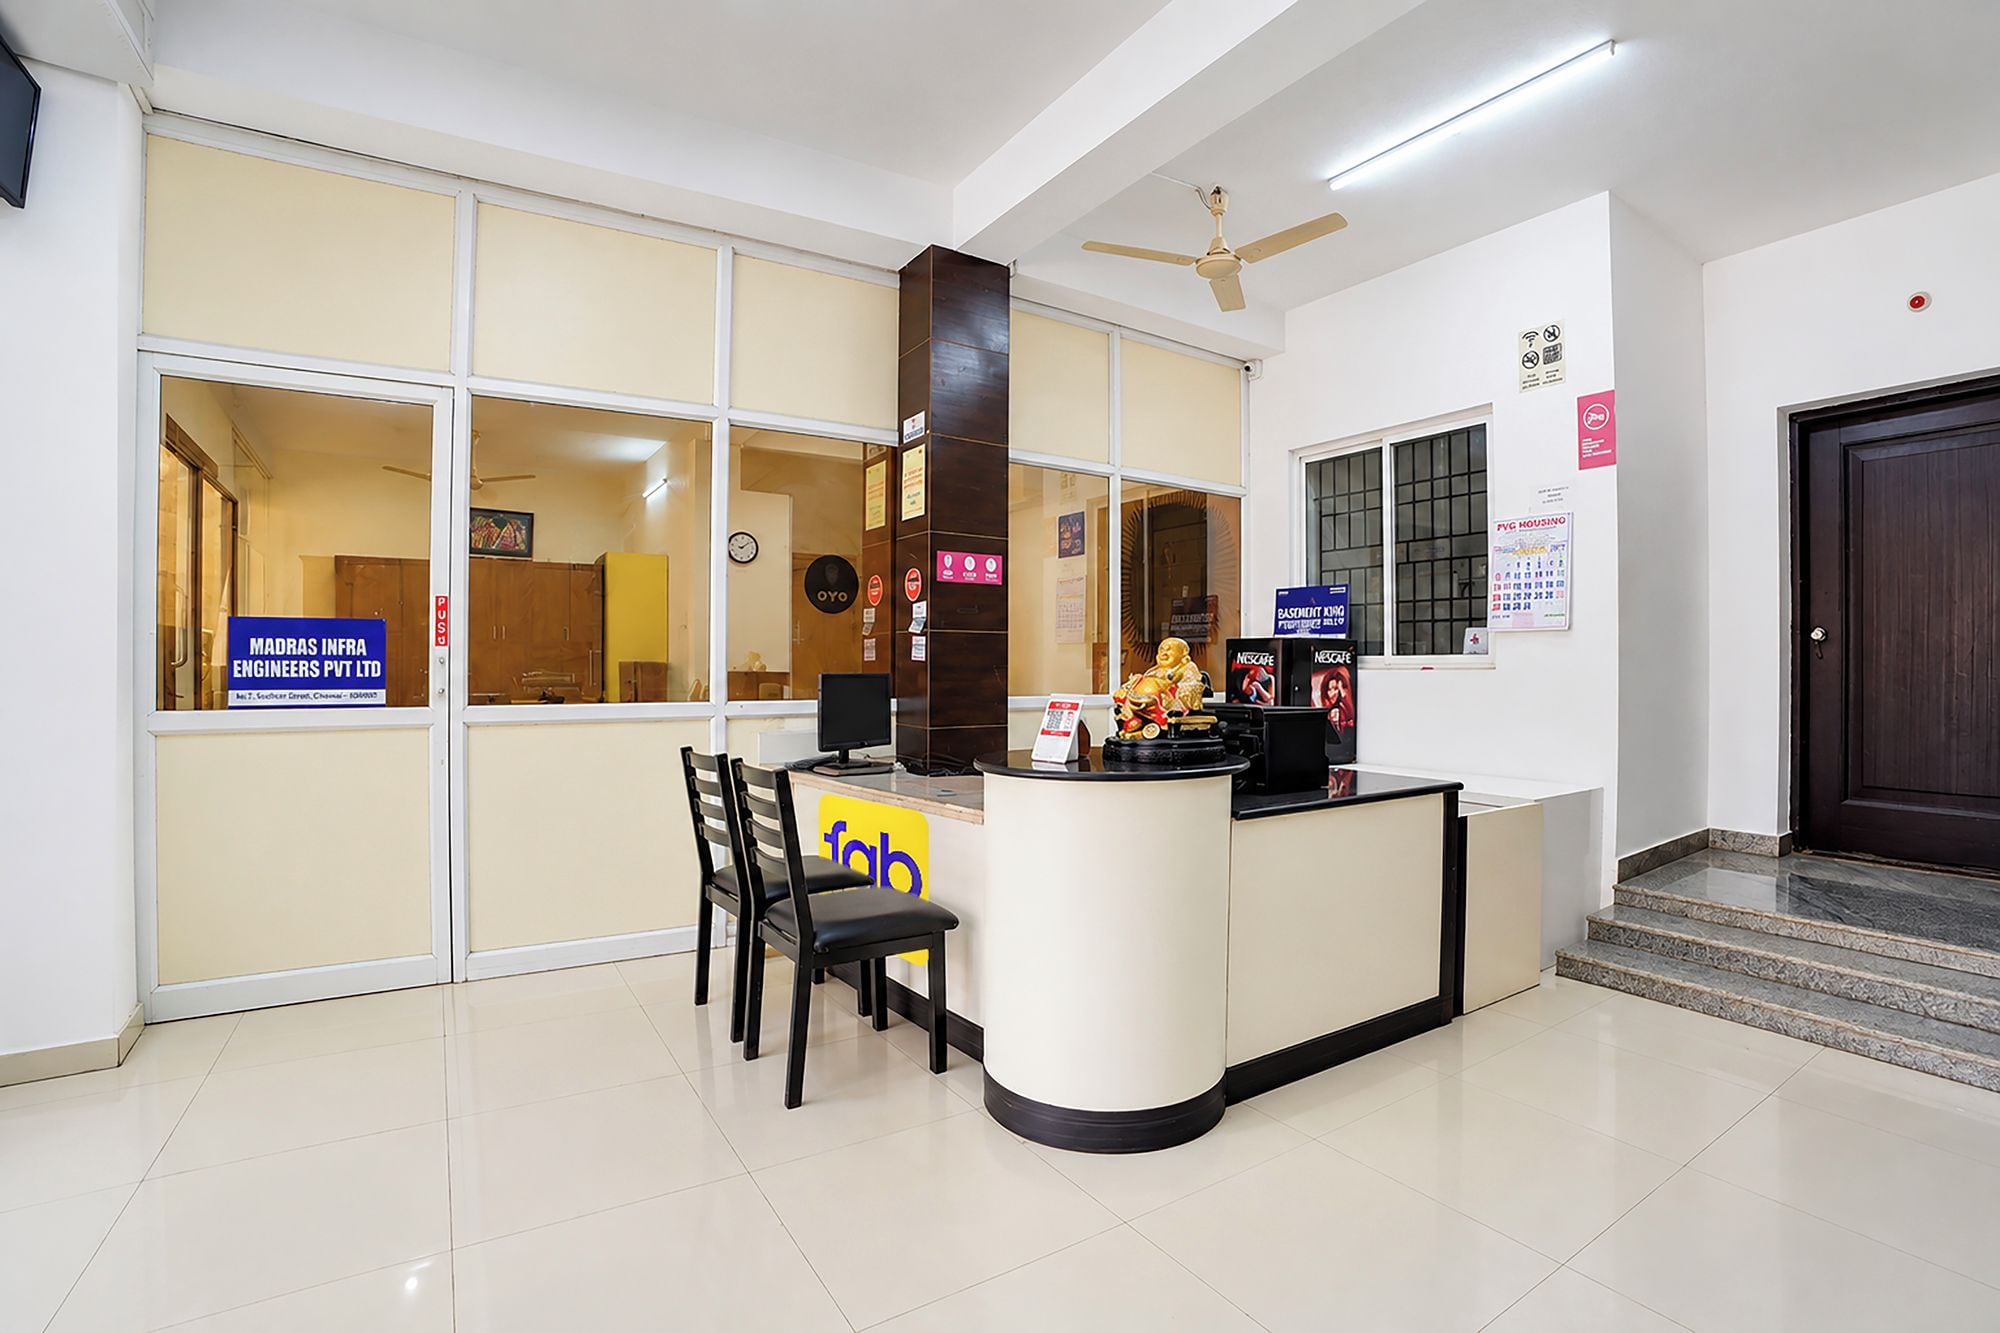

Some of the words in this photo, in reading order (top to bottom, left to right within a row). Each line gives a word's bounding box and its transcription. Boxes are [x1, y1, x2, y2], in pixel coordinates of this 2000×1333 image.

[817, 590, 848, 602] OYO
[249, 637, 317, 656] MADRAS
[321, 638, 367, 656] INFRA
[233, 660, 320, 678] ENGINEERS
[323, 660, 353, 678] PVT
[356, 660, 381, 677] LTD
